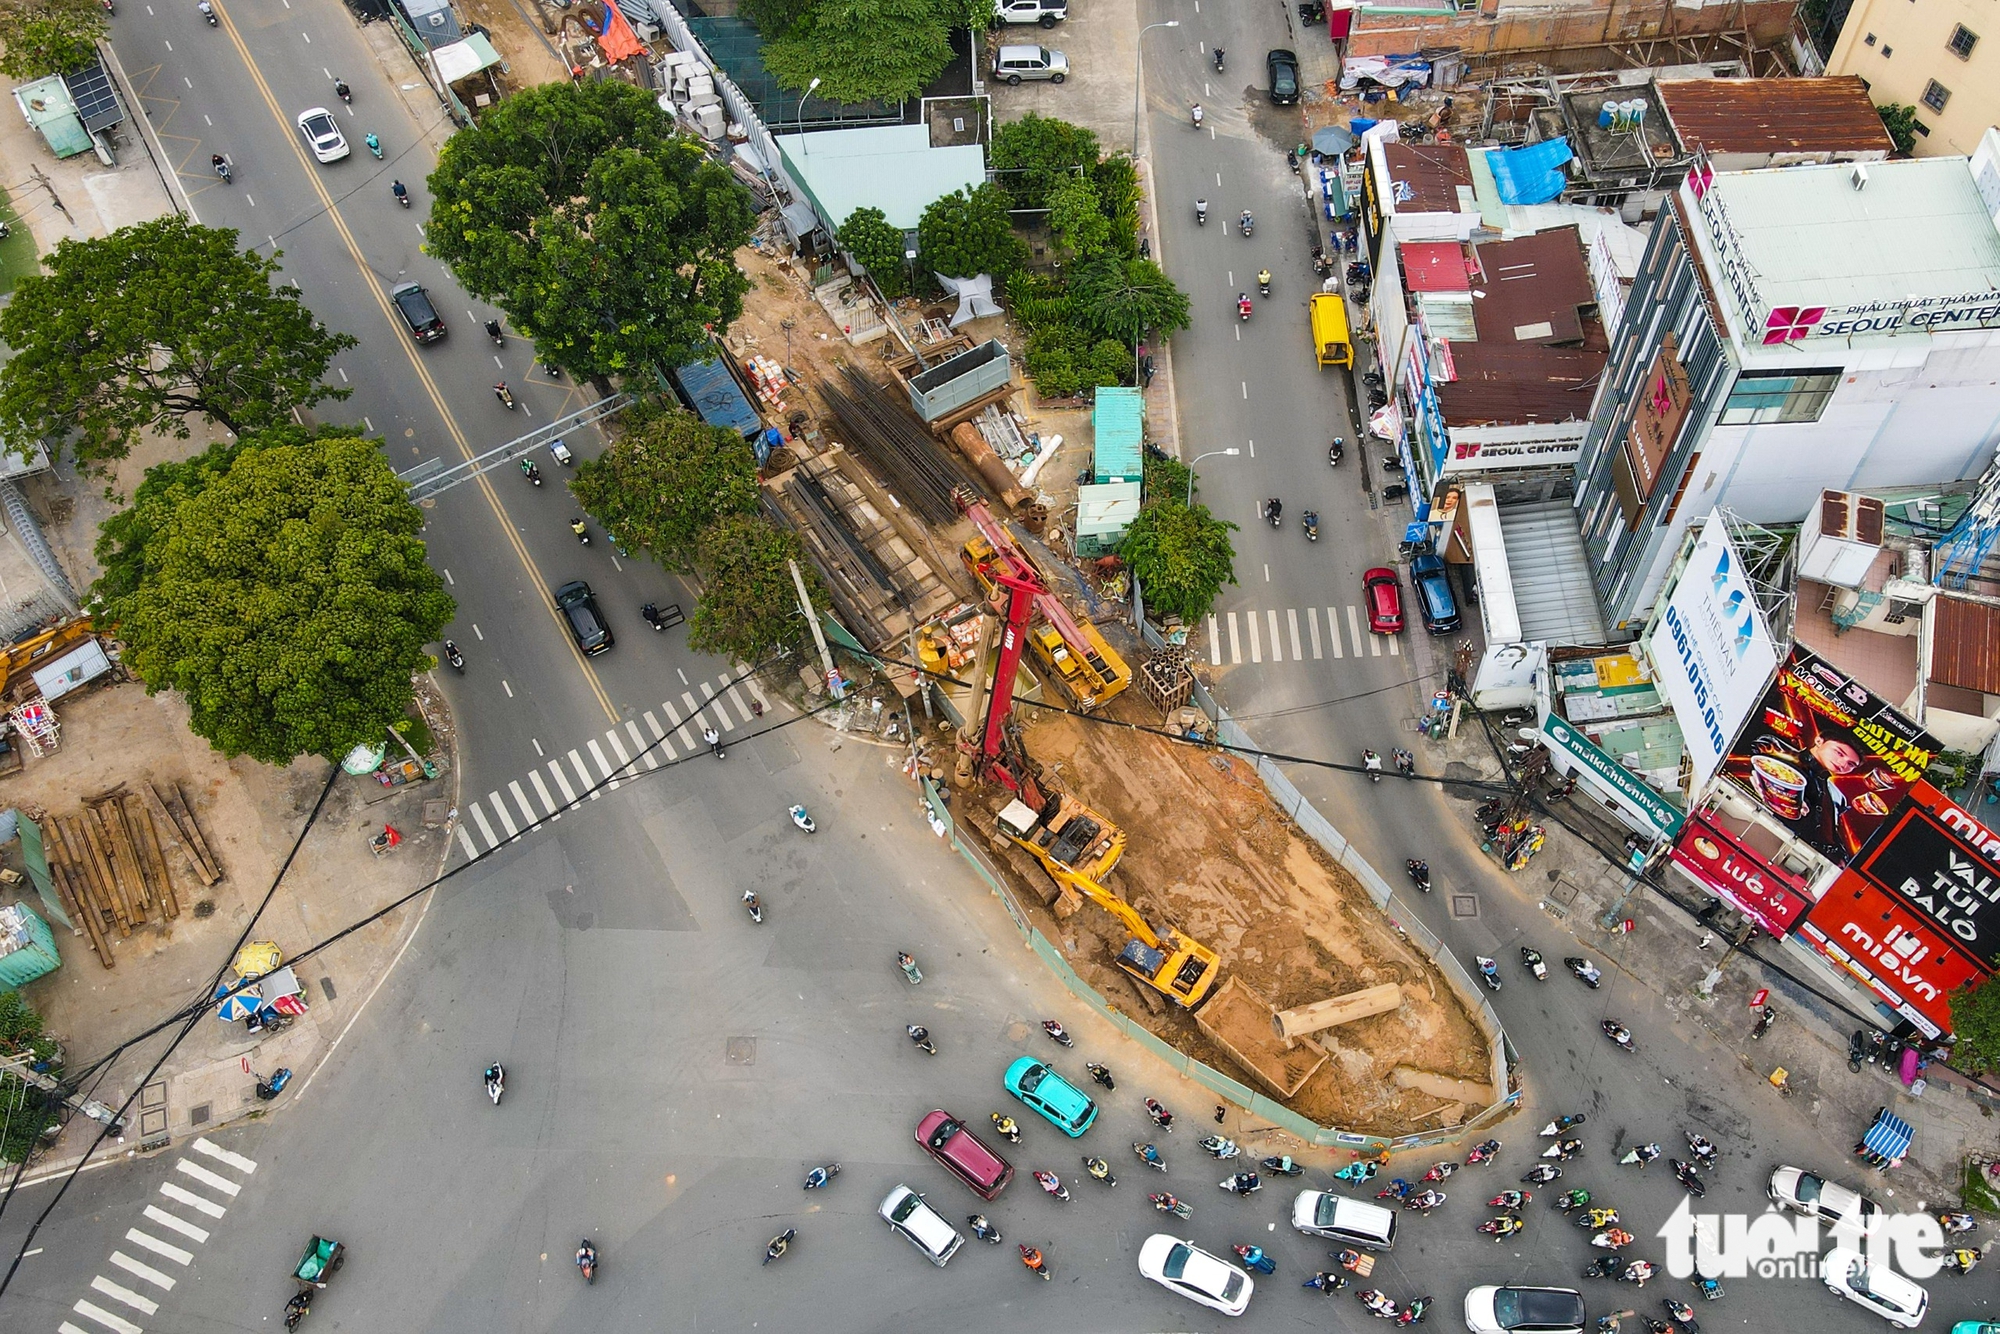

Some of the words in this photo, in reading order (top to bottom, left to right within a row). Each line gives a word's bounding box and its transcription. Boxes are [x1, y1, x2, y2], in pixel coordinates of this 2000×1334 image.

[1703, 197, 1729, 264] SEOUL
[1726, 260, 1758, 340] CENTER
[1819, 315, 1903, 336] SEOUL
[1481, 446, 1524, 457] SEOUL
[1527, 443, 1579, 454] CENTER
[1004, 628, 1015, 650] SANY
[1697, 604, 1730, 685] ADVERTISING
[1666, 605, 1725, 756] 0961.015.016
[1712, 693, 1724, 721] CÁO
[1780, 673, 1855, 728] XTREME
[1570, 740, 1671, 819] matkinhbenhve
[1853, 727, 1887, 756] GIỚI
[1883, 752, 1921, 783] HẠN
[1893, 738, 1930, 769] PHÁ
[1721, 859, 1788, 916] LUG.vn
[1931, 869, 1982, 917] TÚI
[1949, 849, 2000, 903] VALI
[1899, 877, 1977, 941] BALÔ
[1841, 922, 1937, 1002] mia.vn
